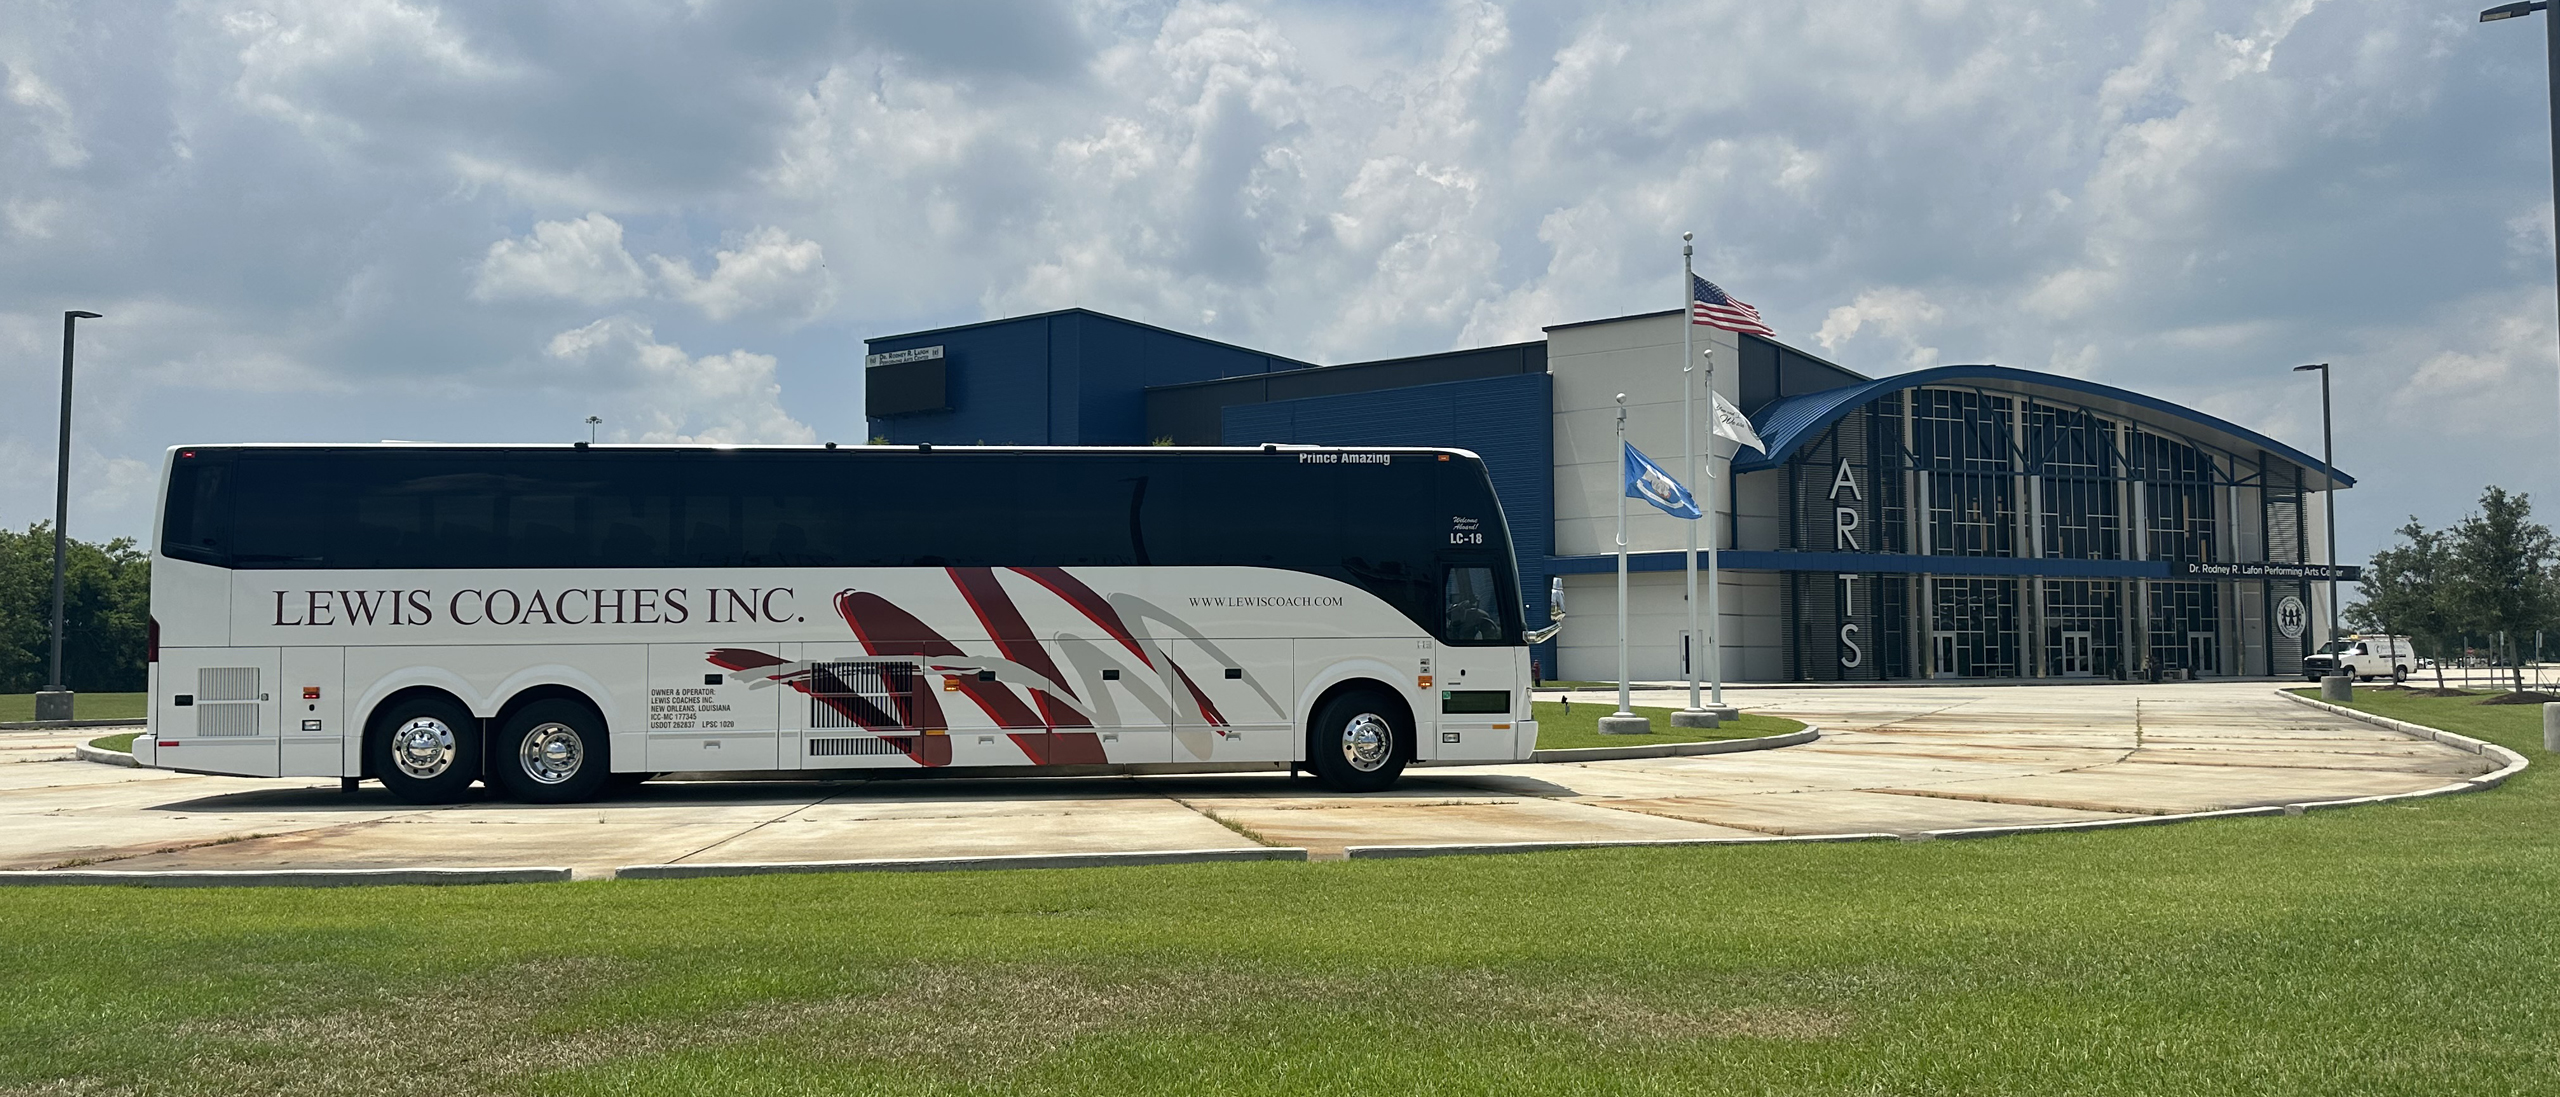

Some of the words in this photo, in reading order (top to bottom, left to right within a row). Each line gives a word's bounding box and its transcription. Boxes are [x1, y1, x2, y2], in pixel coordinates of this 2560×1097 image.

[1299, 453, 1338, 464] Prince
[1341, 453, 1391, 466] Amazing
[1450, 532, 1483, 545] LC-18
[1829, 457, 1862, 668] ARTS
[2189, 563, 2201, 573] Dr.
[2202, 563, 2230, 576] Rodney
[2231, 564, 2241, 574] R.
[2242, 565, 2263, 575] Lafon
[2264, 565, 2303, 578] Performing
[2303, 566, 2320, 576] Arts
[2320, 567, 2344, 577] Ceer
[271, 588, 433, 626] LEWIS
[449, 588, 689, 625] COACHES
[705, 587, 805, 624] INC.
[1189, 596, 1343, 607] WWW.LEWISCOACH.COM
[682, 688, 716, 696] OPERATOR:
[698, 704, 731, 712] LOUISIANA
[702, 720, 718, 728] LPSC
